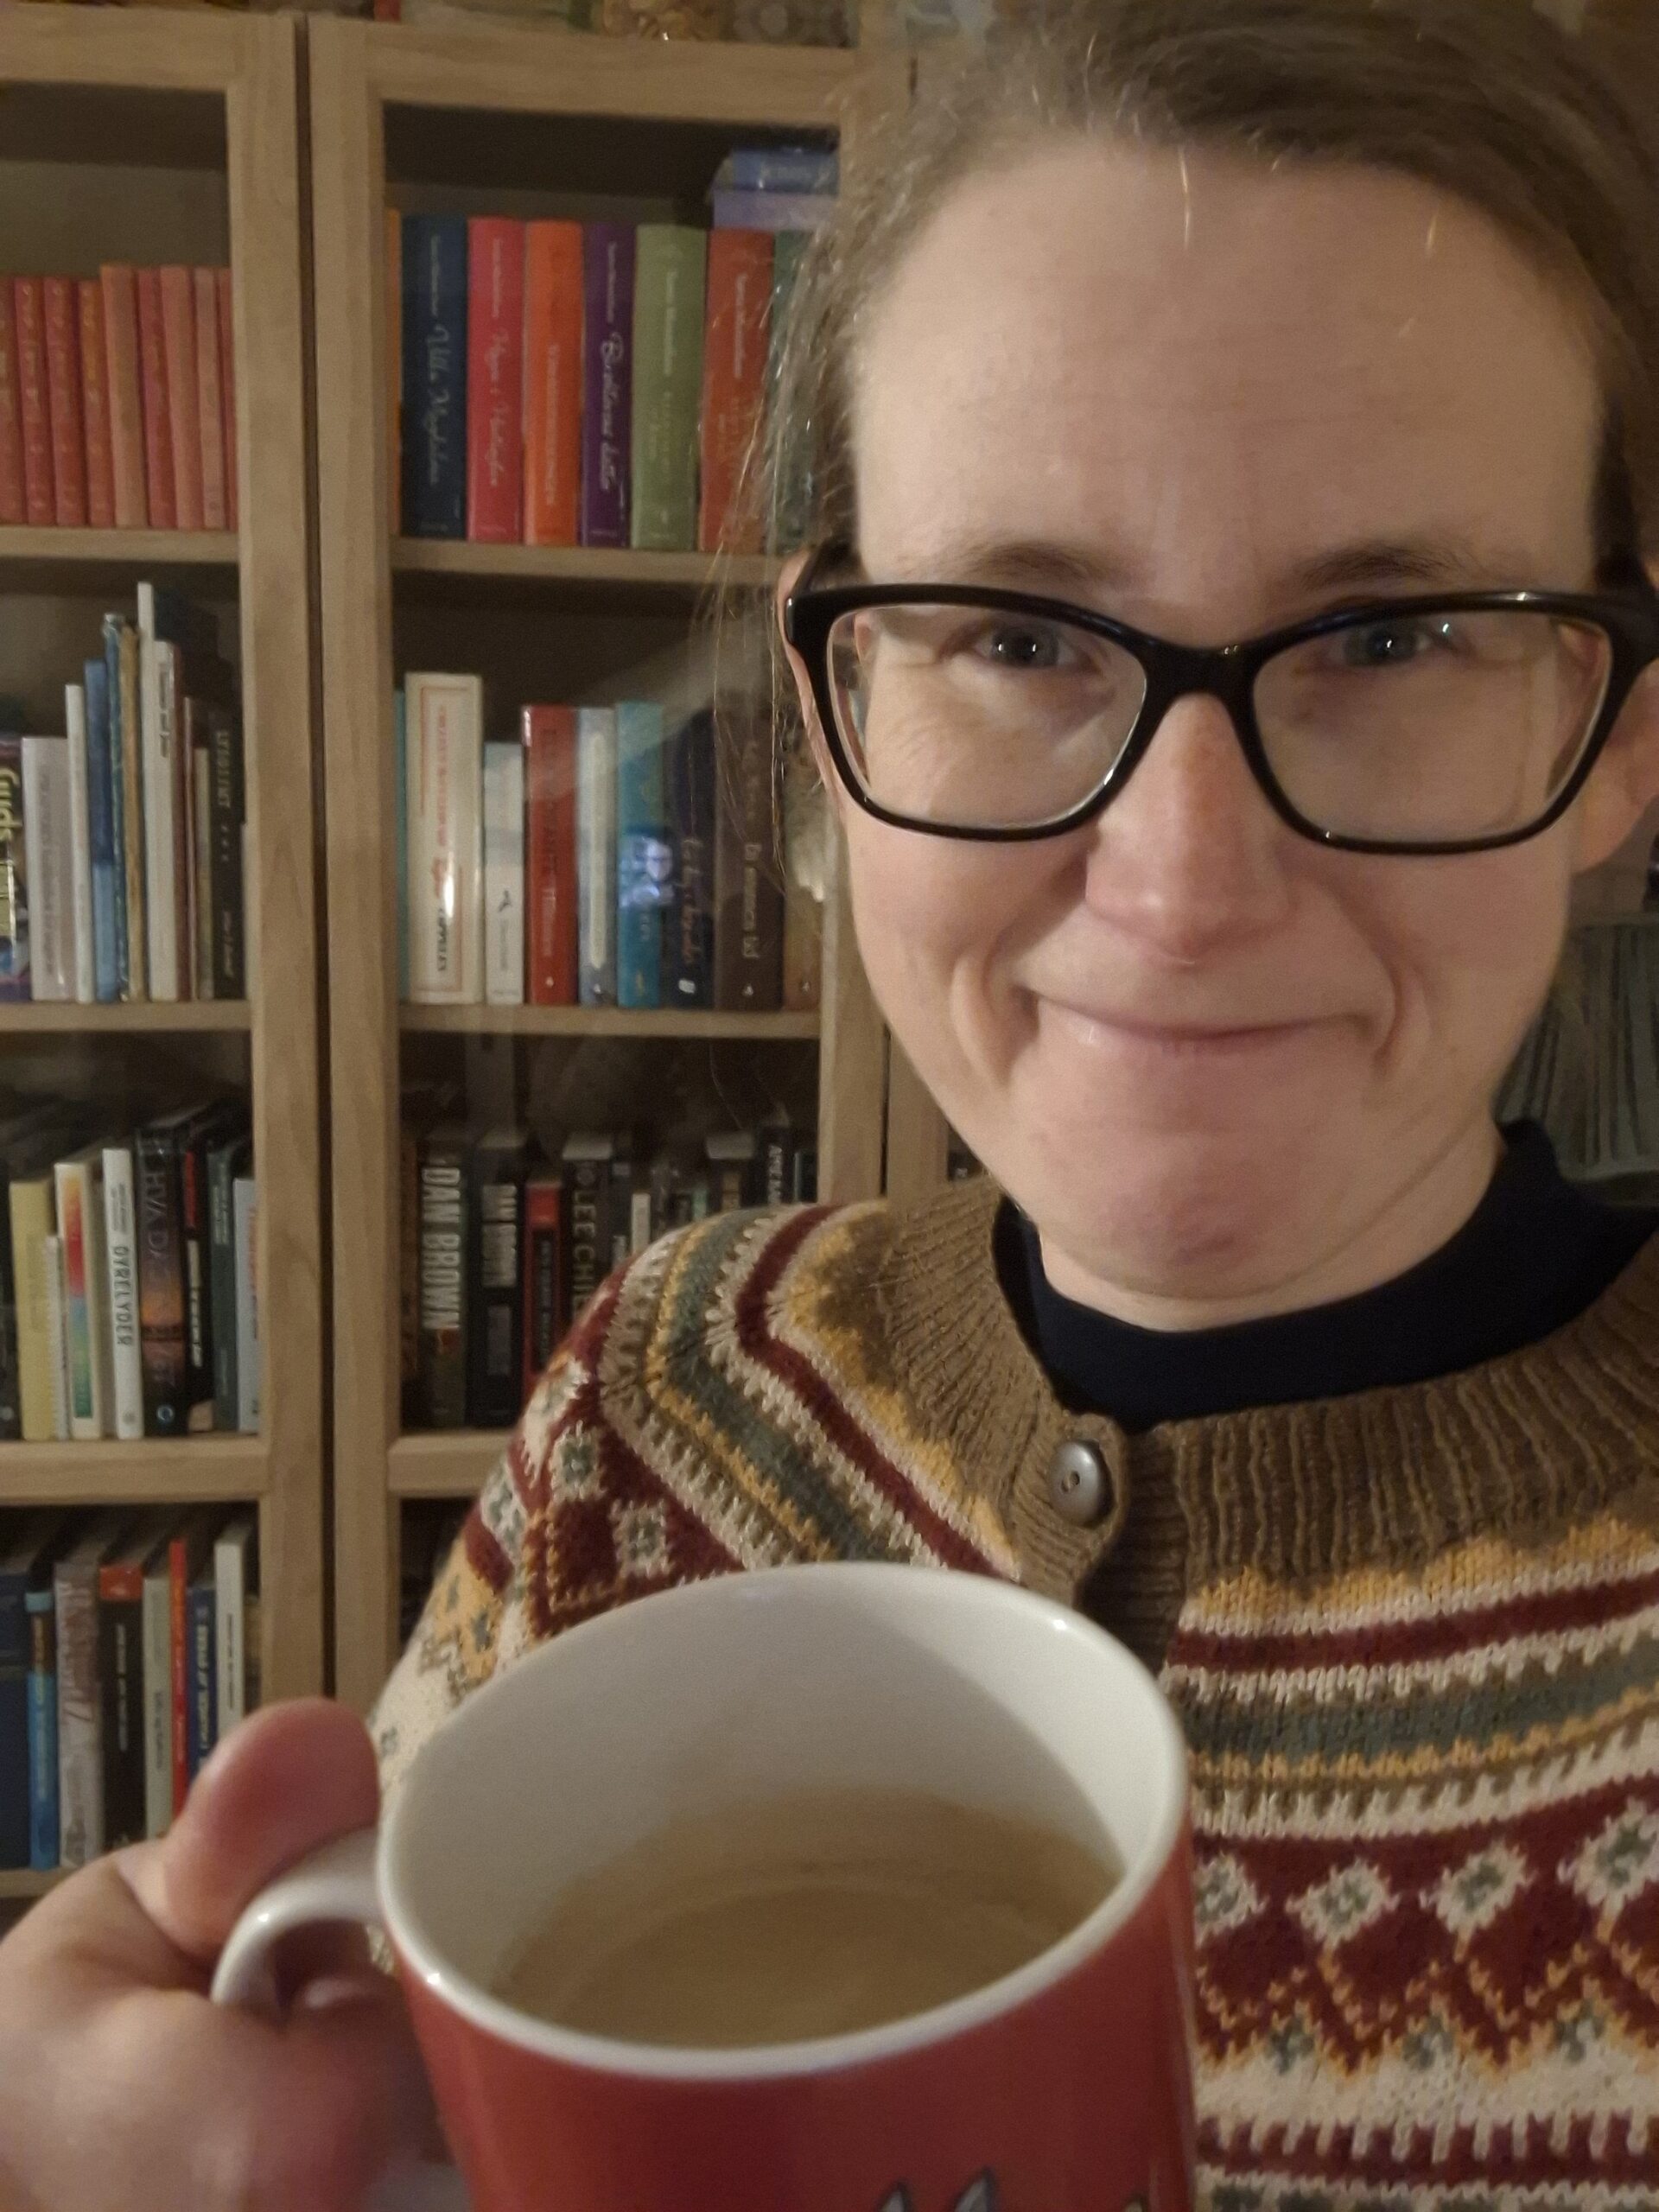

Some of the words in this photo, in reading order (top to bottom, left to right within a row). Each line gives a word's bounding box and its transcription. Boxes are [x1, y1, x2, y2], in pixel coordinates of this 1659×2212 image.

[422, 1167, 461, 1224] DAN
[574, 1190, 595, 1238] LEE
[113, 1244, 131, 1347] DYRELYDER
[422, 1233, 461, 1330] BROWN
[573, 1245, 594, 1310] CHIL
